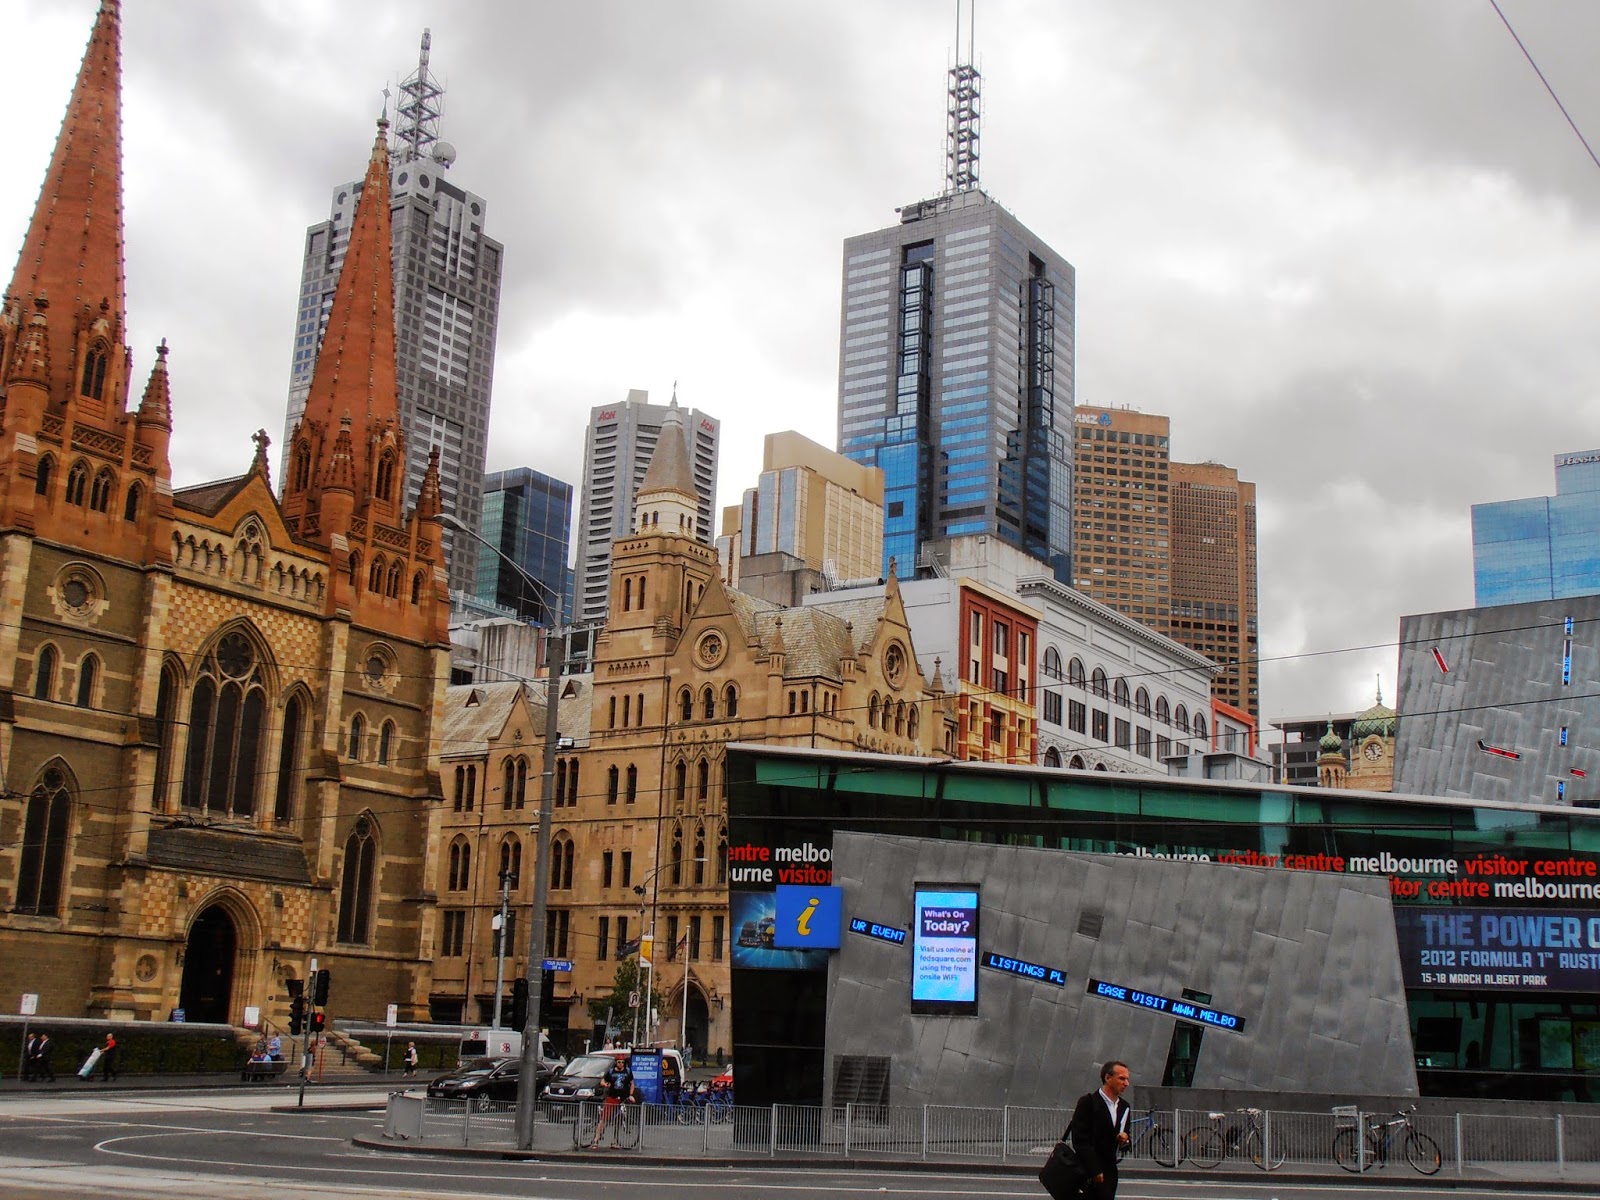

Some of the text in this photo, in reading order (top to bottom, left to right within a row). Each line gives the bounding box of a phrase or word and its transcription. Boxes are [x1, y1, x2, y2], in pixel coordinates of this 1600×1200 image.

[1074, 413, 1099, 425] ANZ
[775, 842, 833, 862] melbo
[729, 866, 773, 882] urne
[1284, 852, 1345, 872] centre
[1350, 852, 1458, 874] melbourne
[1463, 853, 1529, 876] visitor
[1534, 856, 1597, 877] centre
[1428, 877, 1490, 898] centre
[924, 910, 965, 918] What's On
[851, 919, 905, 942] UR EVENT
[924, 920, 970, 934] Today?
[1420, 914, 1475, 946] THE
[1480, 915, 1582, 949] POWER
[920, 945, 935, 953] Visit
[920, 954, 971, 963] fedsquare.com
[990, 955, 1065, 983] LISTINGS PL
[1420, 950, 1456, 967] 2012
[1460, 950, 1532, 968] FORMULA
[1559, 952, 1600, 969] AUST
[1421, 972, 1548, 986] 15-18 MARCH ALBERT PARK
[1097, 983, 1237, 1027] EASE VISIT WWW.MELBO
